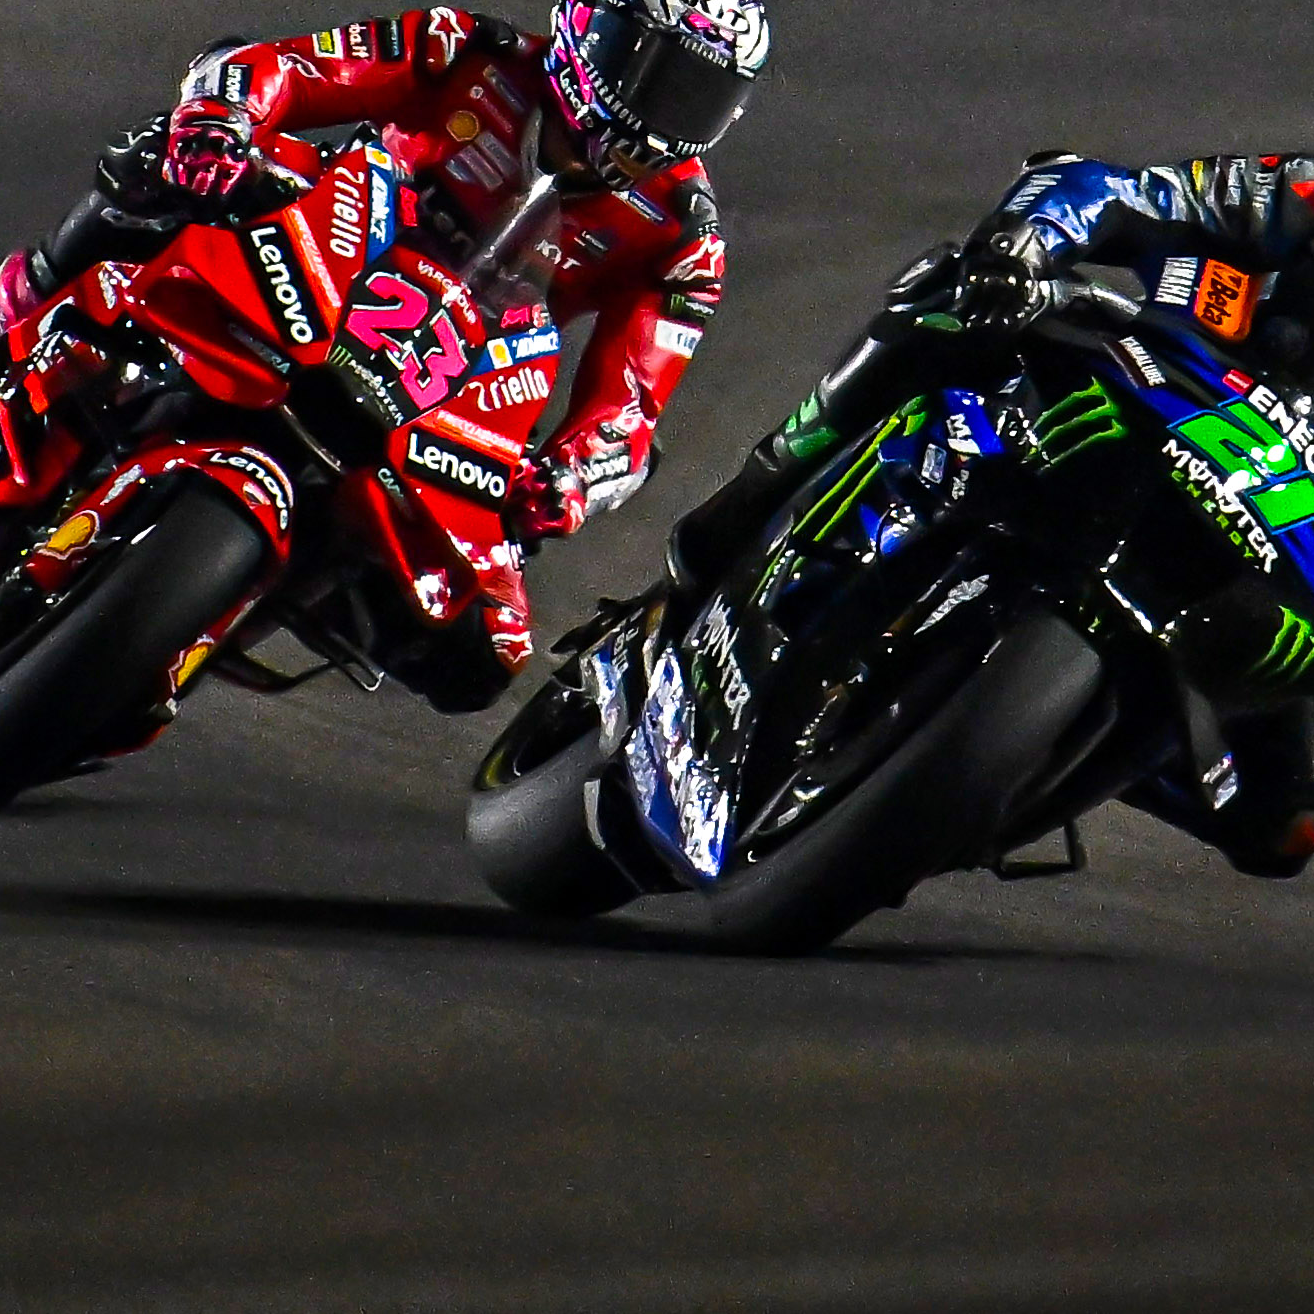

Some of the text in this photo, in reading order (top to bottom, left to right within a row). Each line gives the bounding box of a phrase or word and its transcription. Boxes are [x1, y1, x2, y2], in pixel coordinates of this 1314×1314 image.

[559, 67, 595, 128] Lenoo
[329, 180, 365, 258] riello
[250, 226, 314, 345] Lenovo
[343, 270, 469, 412] 23
[489, 366, 551, 410] riello
[407, 432, 506, 499] Lenovo
